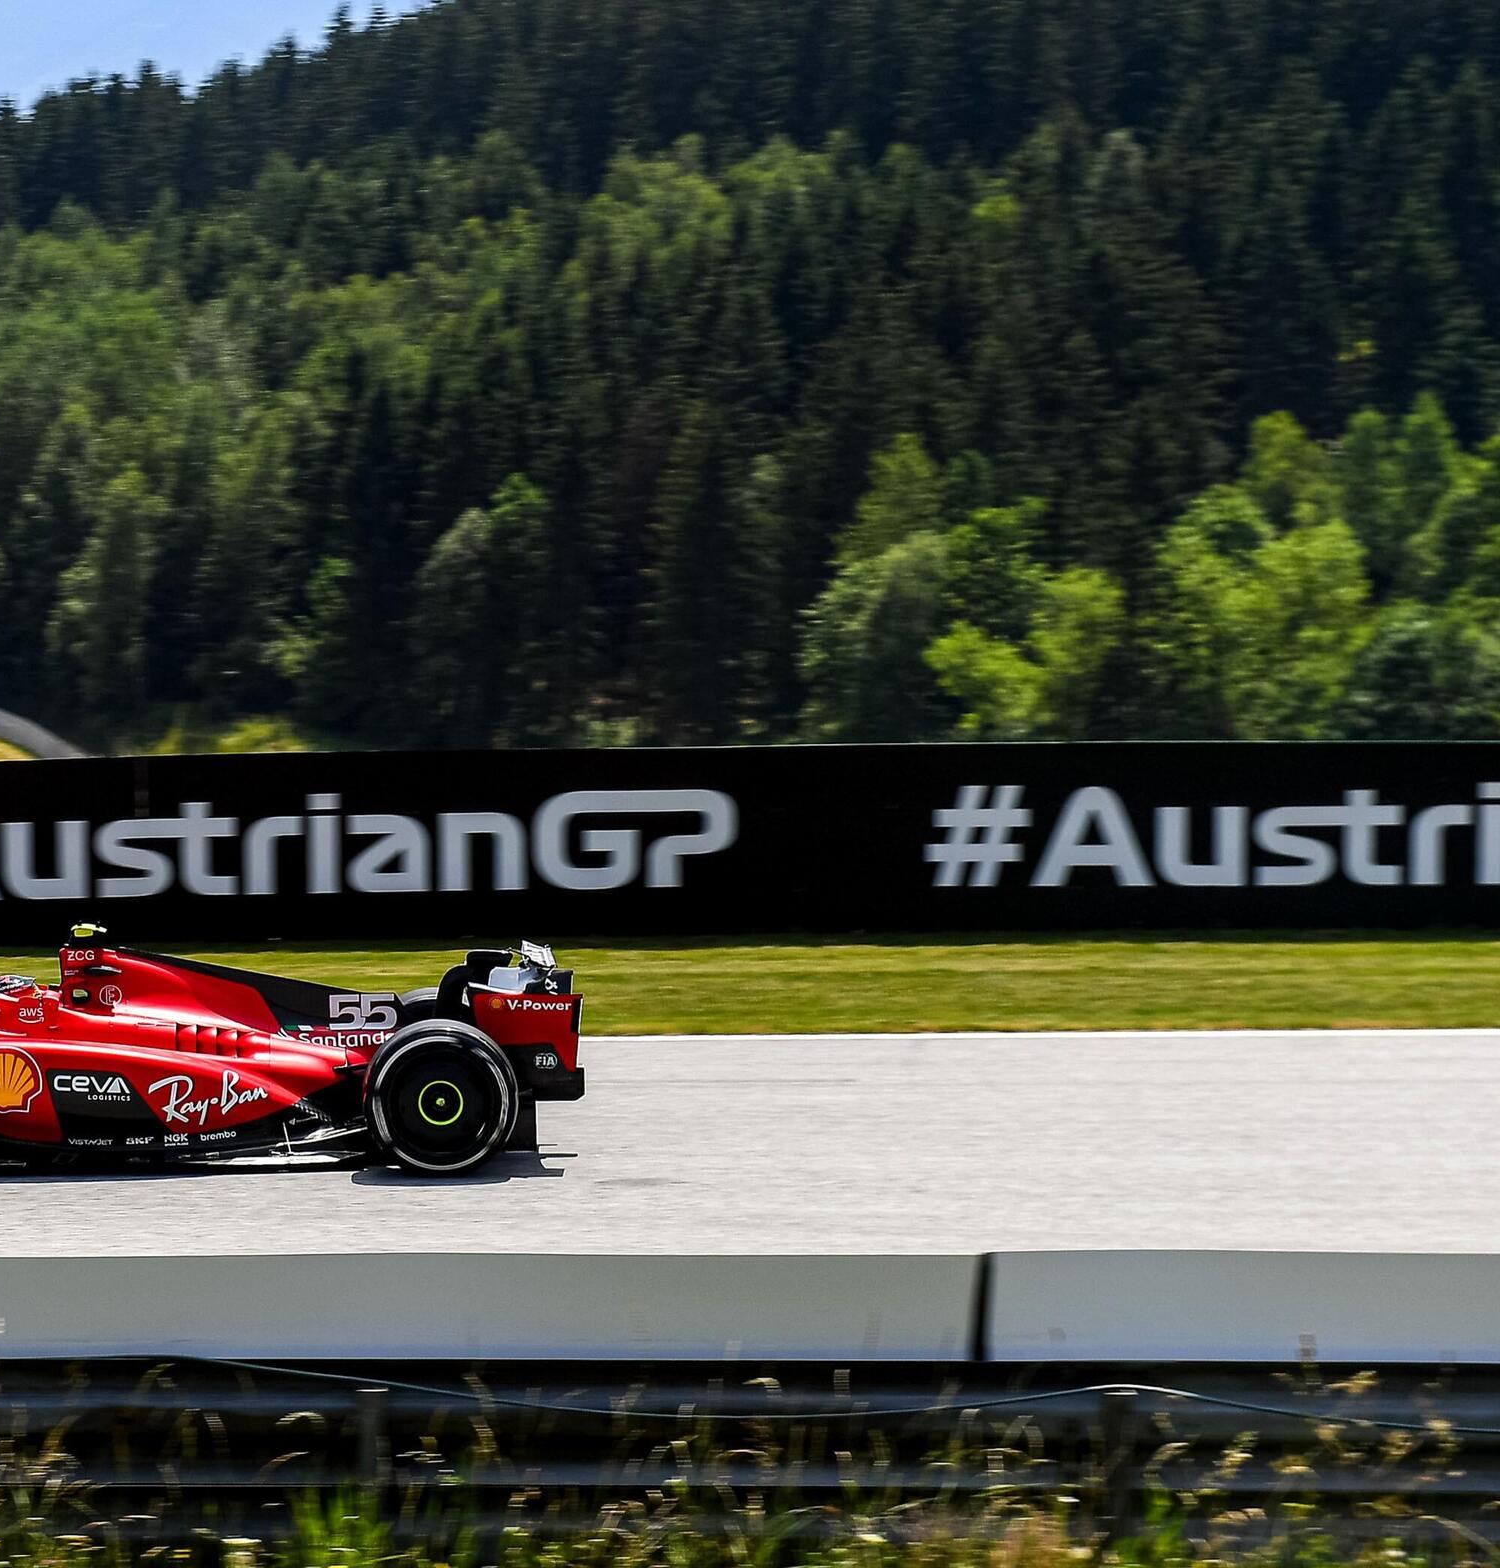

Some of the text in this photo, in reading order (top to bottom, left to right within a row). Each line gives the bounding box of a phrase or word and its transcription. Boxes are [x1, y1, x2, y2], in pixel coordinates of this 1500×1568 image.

[67, 949, 95, 961] ZCG
[507, 999, 572, 1011] V-Power
[19, 1007, 44, 1017] aws
[329, 993, 398, 1031] 55
[298, 1030, 395, 1048] Santande
[535, 1055, 556, 1067] FIA
[87, 1094, 131, 1102] LOGISTICS
[164, 1132, 189, 1143] NGK
[200, 1130, 237, 1142] brembo
